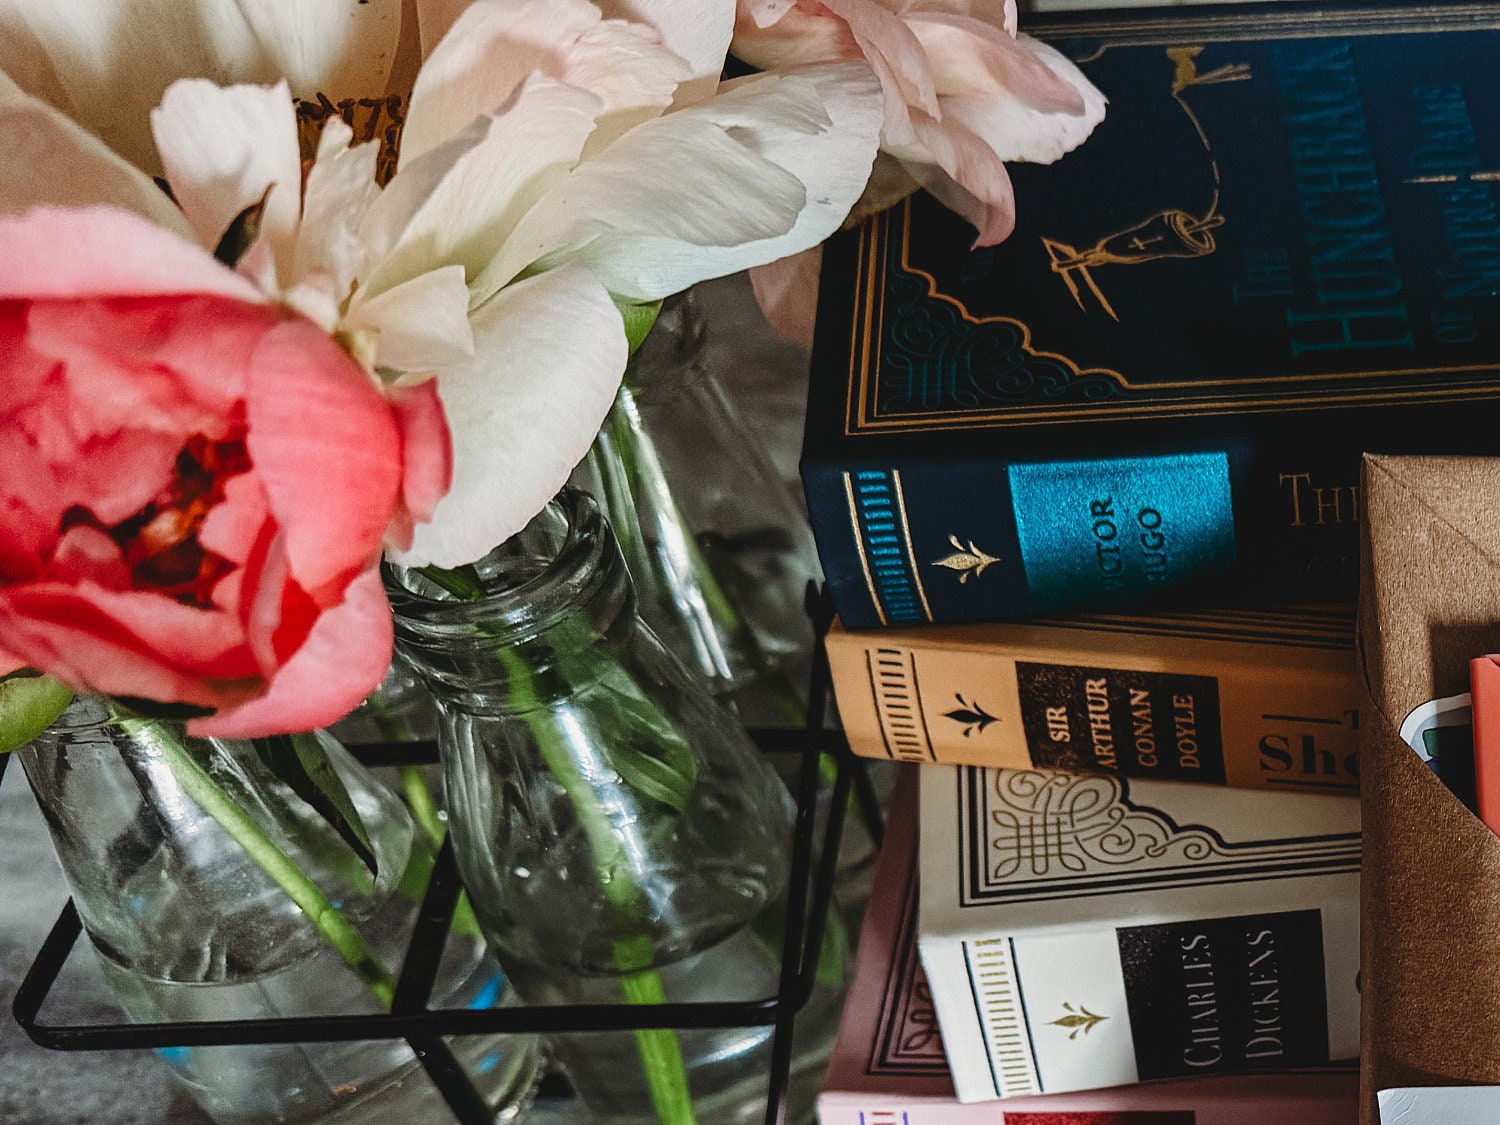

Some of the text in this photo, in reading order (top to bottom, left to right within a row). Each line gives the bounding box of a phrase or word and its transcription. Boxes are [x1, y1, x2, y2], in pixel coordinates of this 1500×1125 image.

[1272, 39, 1414, 357] HUNCHBACK
[1046, 704, 1072, 743] SIR
[1085, 677, 1119, 770] ARTHUR
[1129, 687, 1158, 768] CONAN
[1172, 694, 1201, 769] DOYLE
[1181, 934, 1222, 1066] CHARLES
[1245, 930, 1284, 1058] DICKENS
